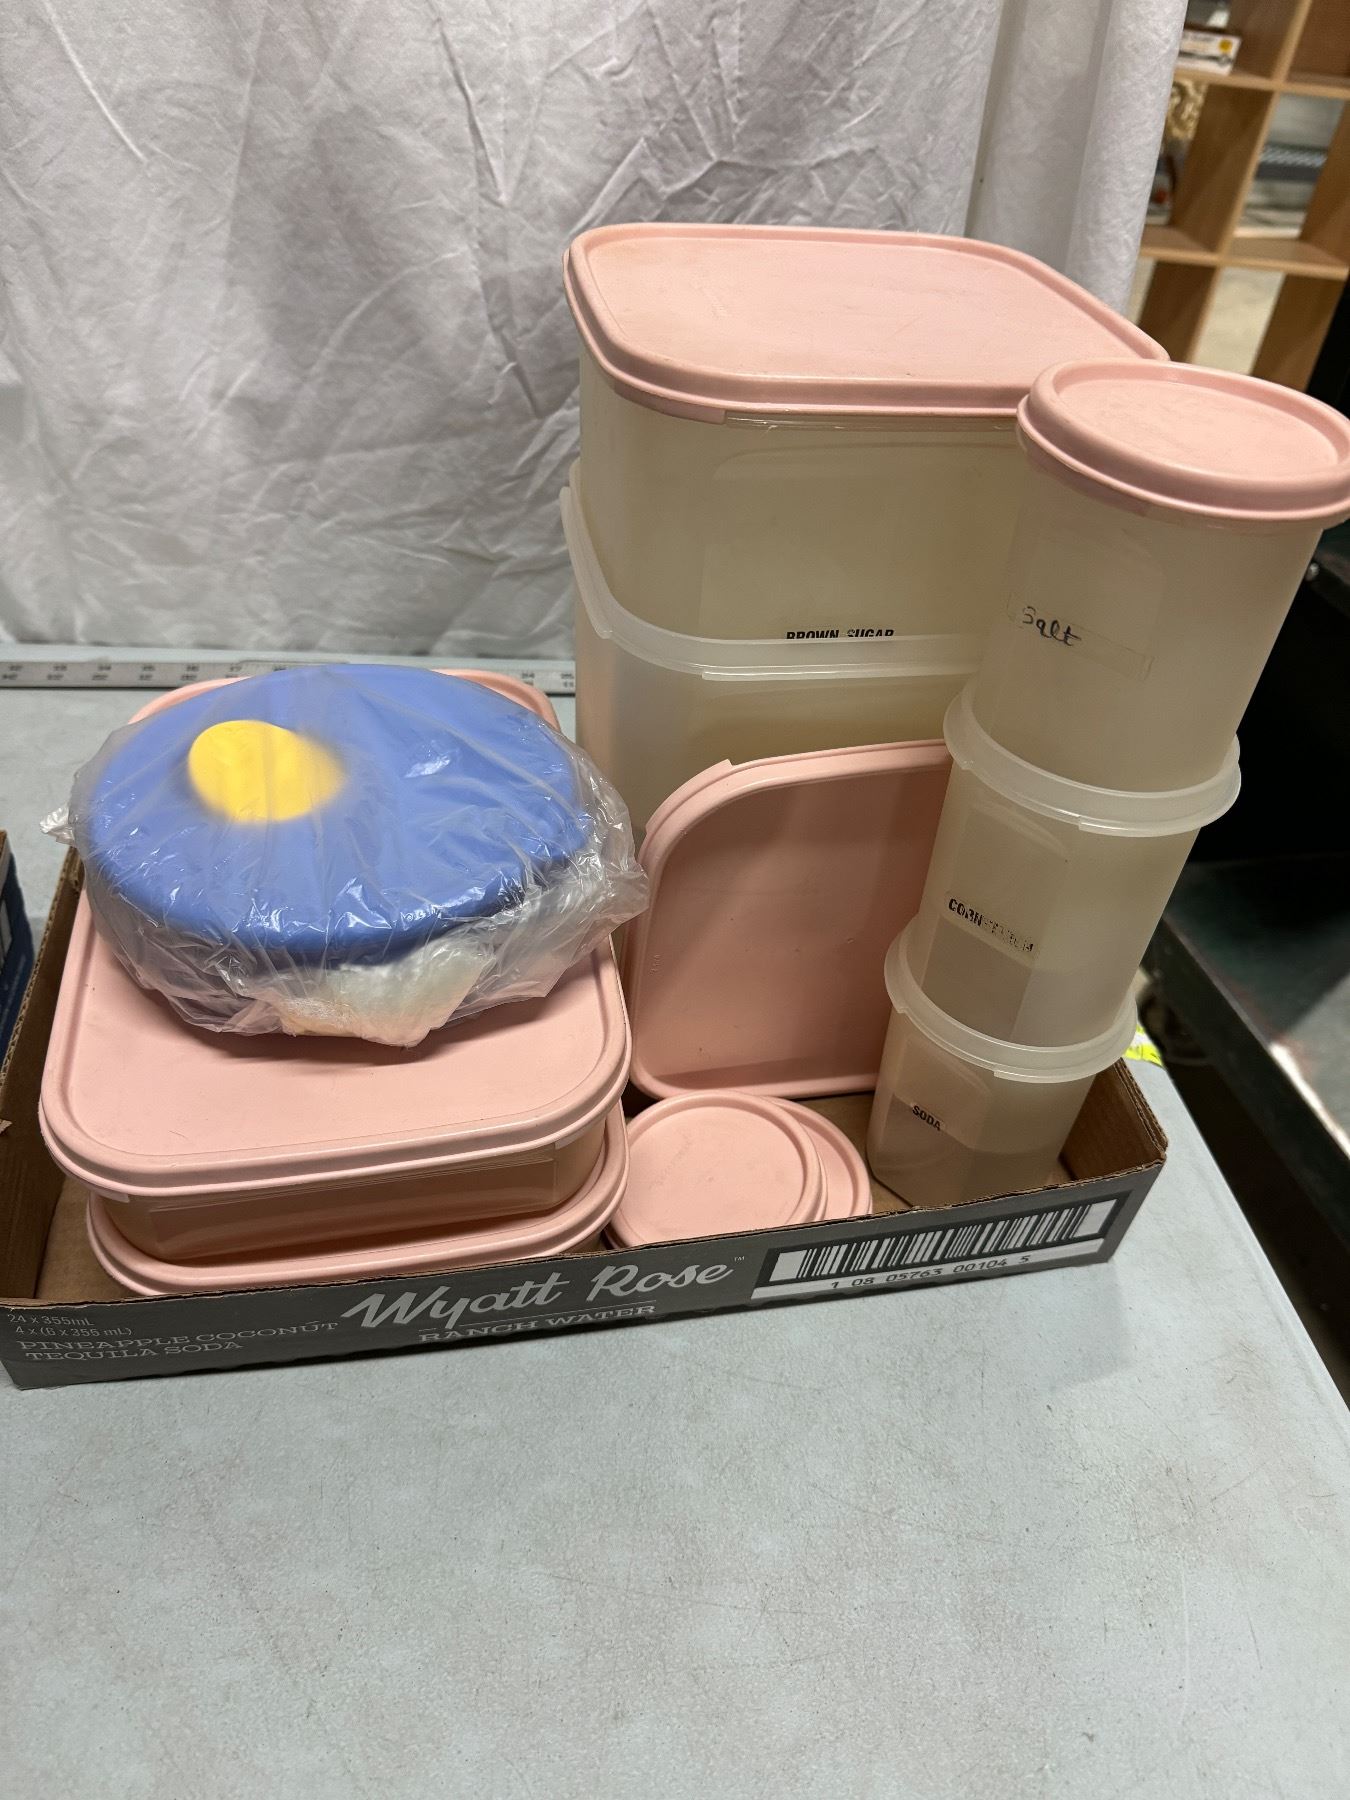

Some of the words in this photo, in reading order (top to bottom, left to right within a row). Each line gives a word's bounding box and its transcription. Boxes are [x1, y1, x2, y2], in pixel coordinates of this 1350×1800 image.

[1022, 605, 1082, 647] Salt
[912, 1105, 941, 1131] SODA
[851, 1276, 875, 1287] 08
[885, 1268, 943, 1282] 05763
[953, 1259, 1008, 1273] 00104
[1019, 1255, 1031, 1264] 5
[341, 1272, 571, 1329] Wyatt
[585, 1263, 733, 1302] Rose
[7, 1313, 27, 1323] 24
[419, 1320, 539, 1342] RANCH
[546, 1305, 656, 1326] WATER
[17, 1336, 191, 1350] PINEAPPLE
[196, 1322, 339, 1341] COCONUT
[25, 1348, 157, 1360] TEQUILA
[164, 1341, 244, 1354] SODA
